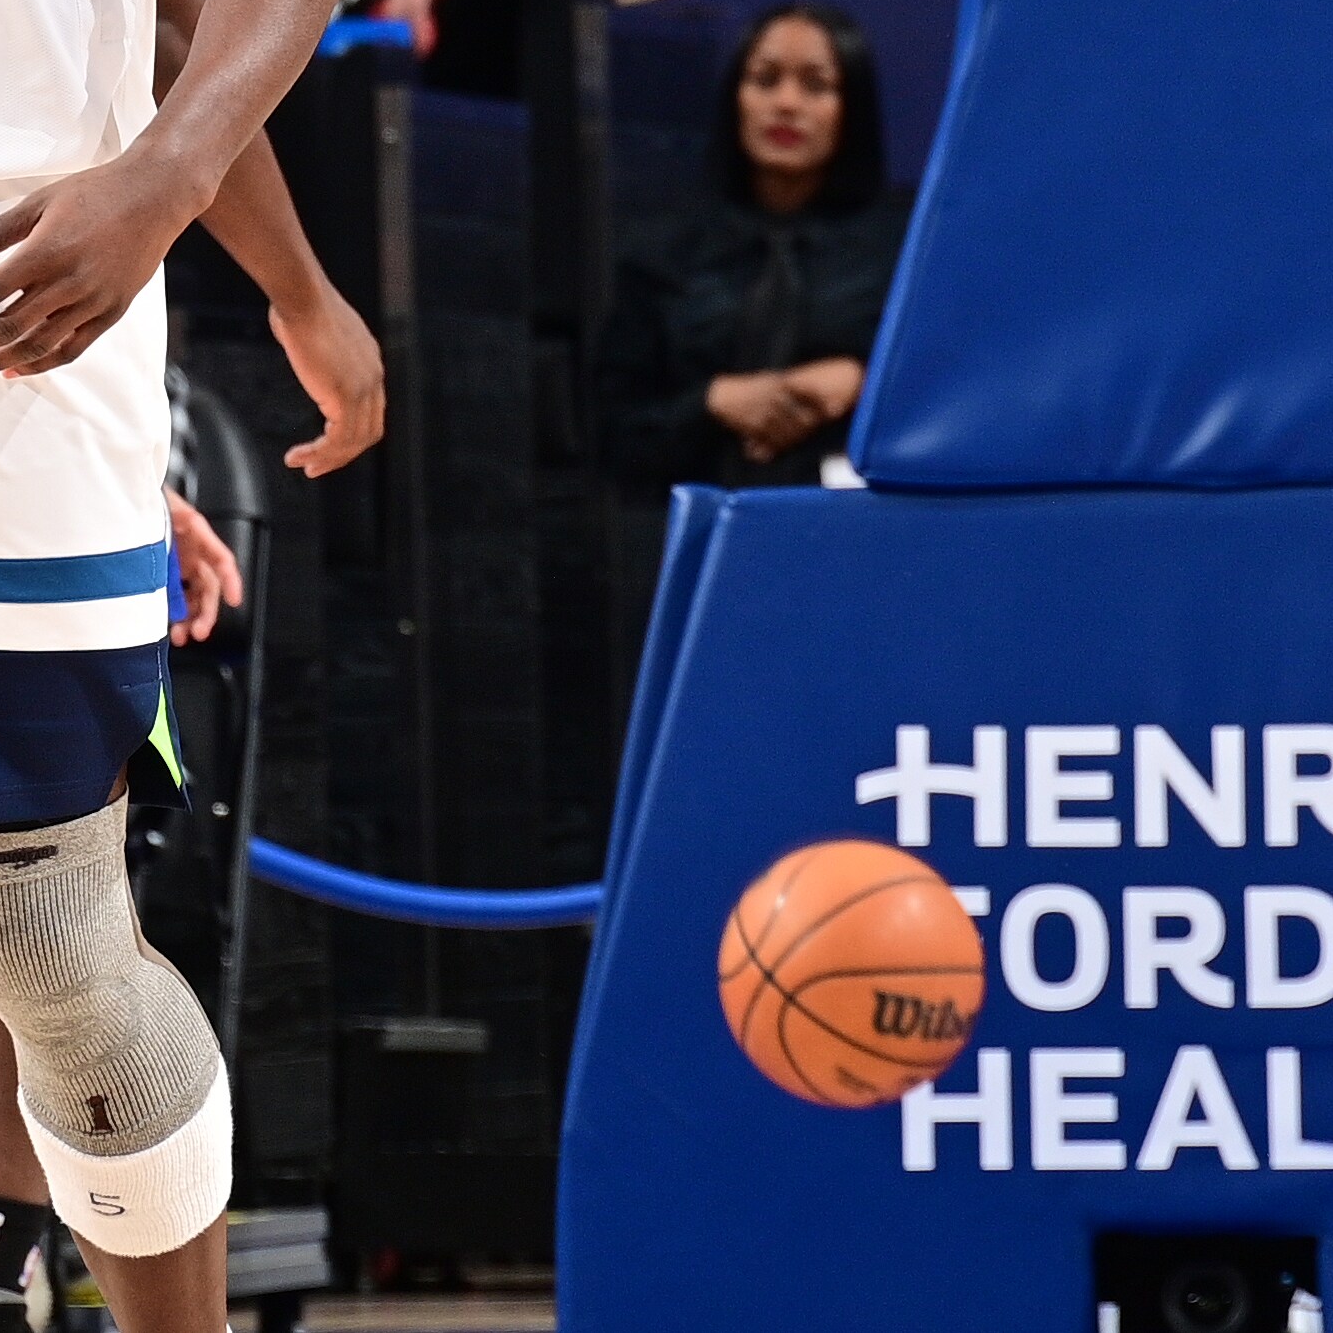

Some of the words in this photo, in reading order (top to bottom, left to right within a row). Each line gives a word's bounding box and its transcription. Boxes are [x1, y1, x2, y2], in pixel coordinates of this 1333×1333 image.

[855, 723, 1333, 848] HENR
[951, 883, 1333, 1011] ORD
[900, 1044, 1333, 1172] HEAL
[88, 1191, 126, 1216] 5
